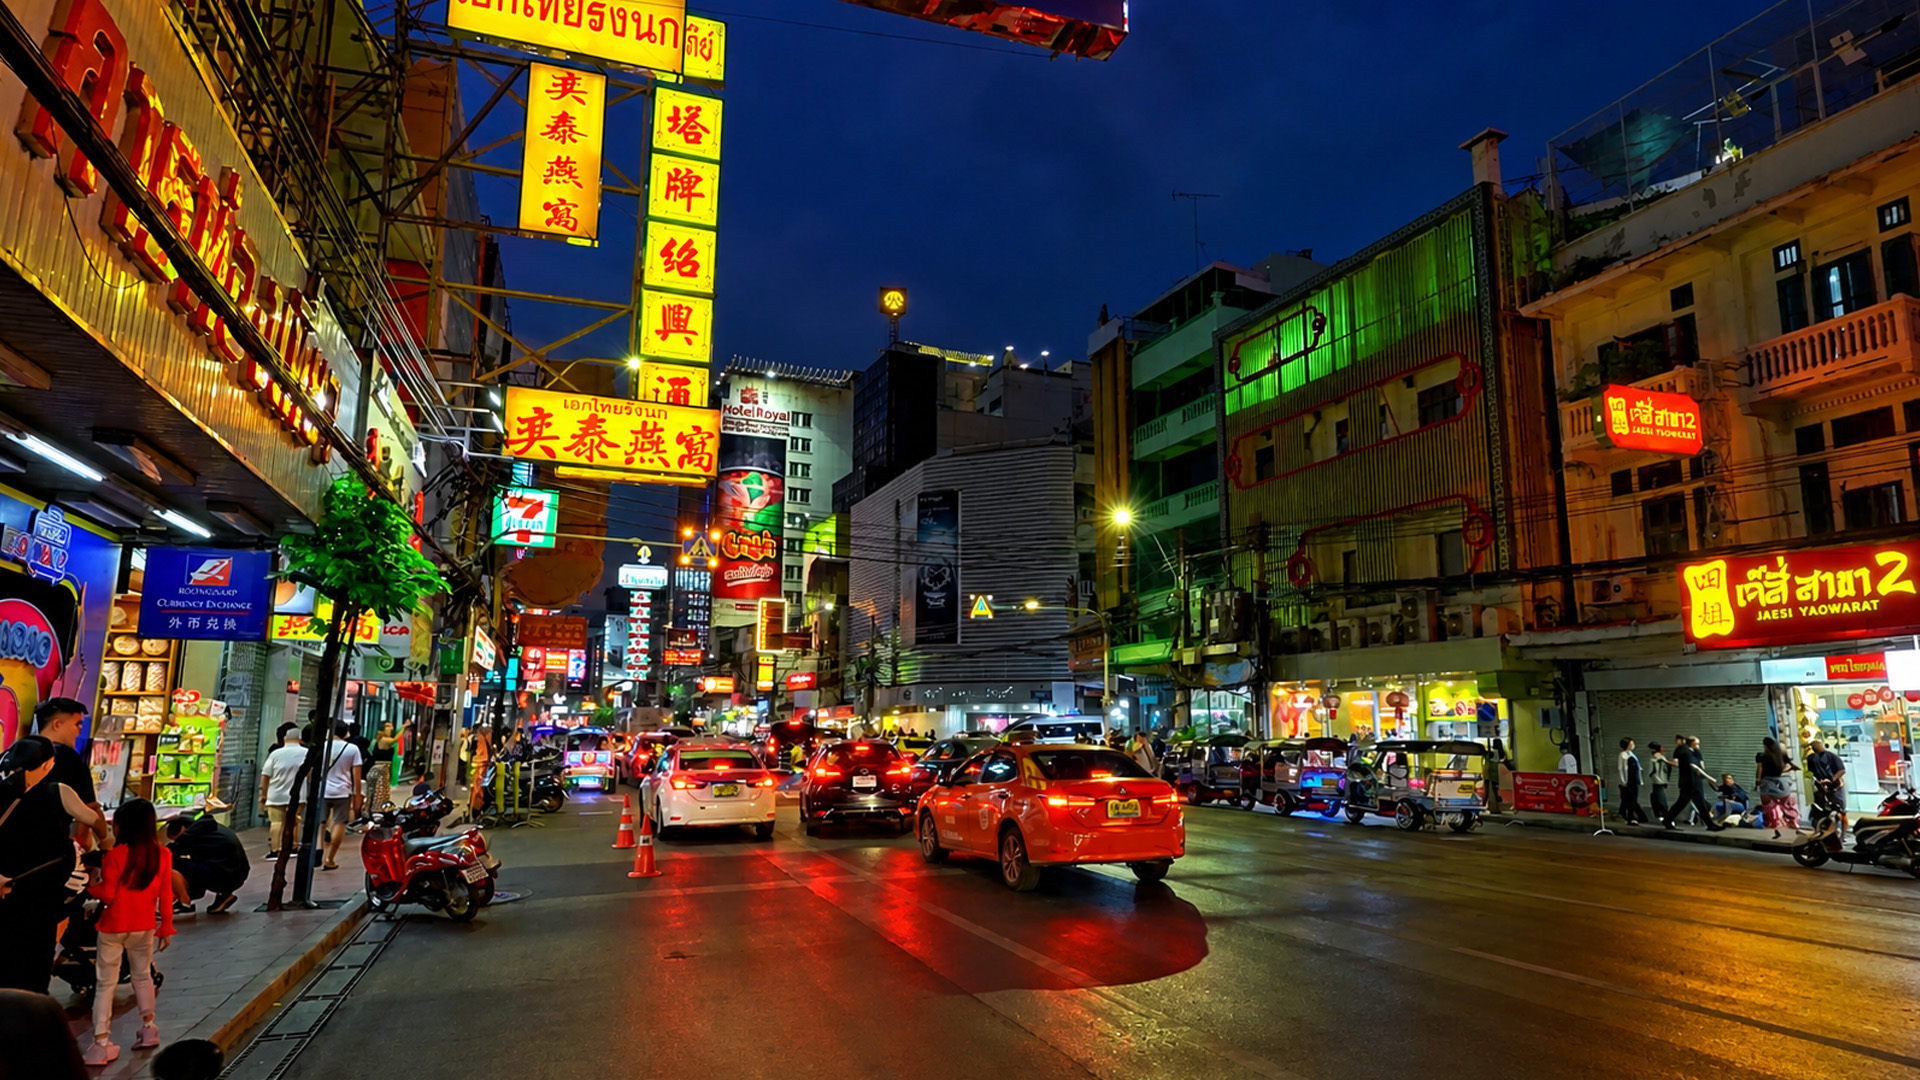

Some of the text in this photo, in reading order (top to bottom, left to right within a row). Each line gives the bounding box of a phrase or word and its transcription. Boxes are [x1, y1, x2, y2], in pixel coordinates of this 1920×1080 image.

[563, 398, 668, 420] เอกไทยรังนก
[722, 404, 791, 423] Hotel Royal
[1794, 567, 1872, 602] สาขา
[1874, 551, 1917, 596] 2
[1756, 600, 1880, 621] JAESI YAOWARAT
